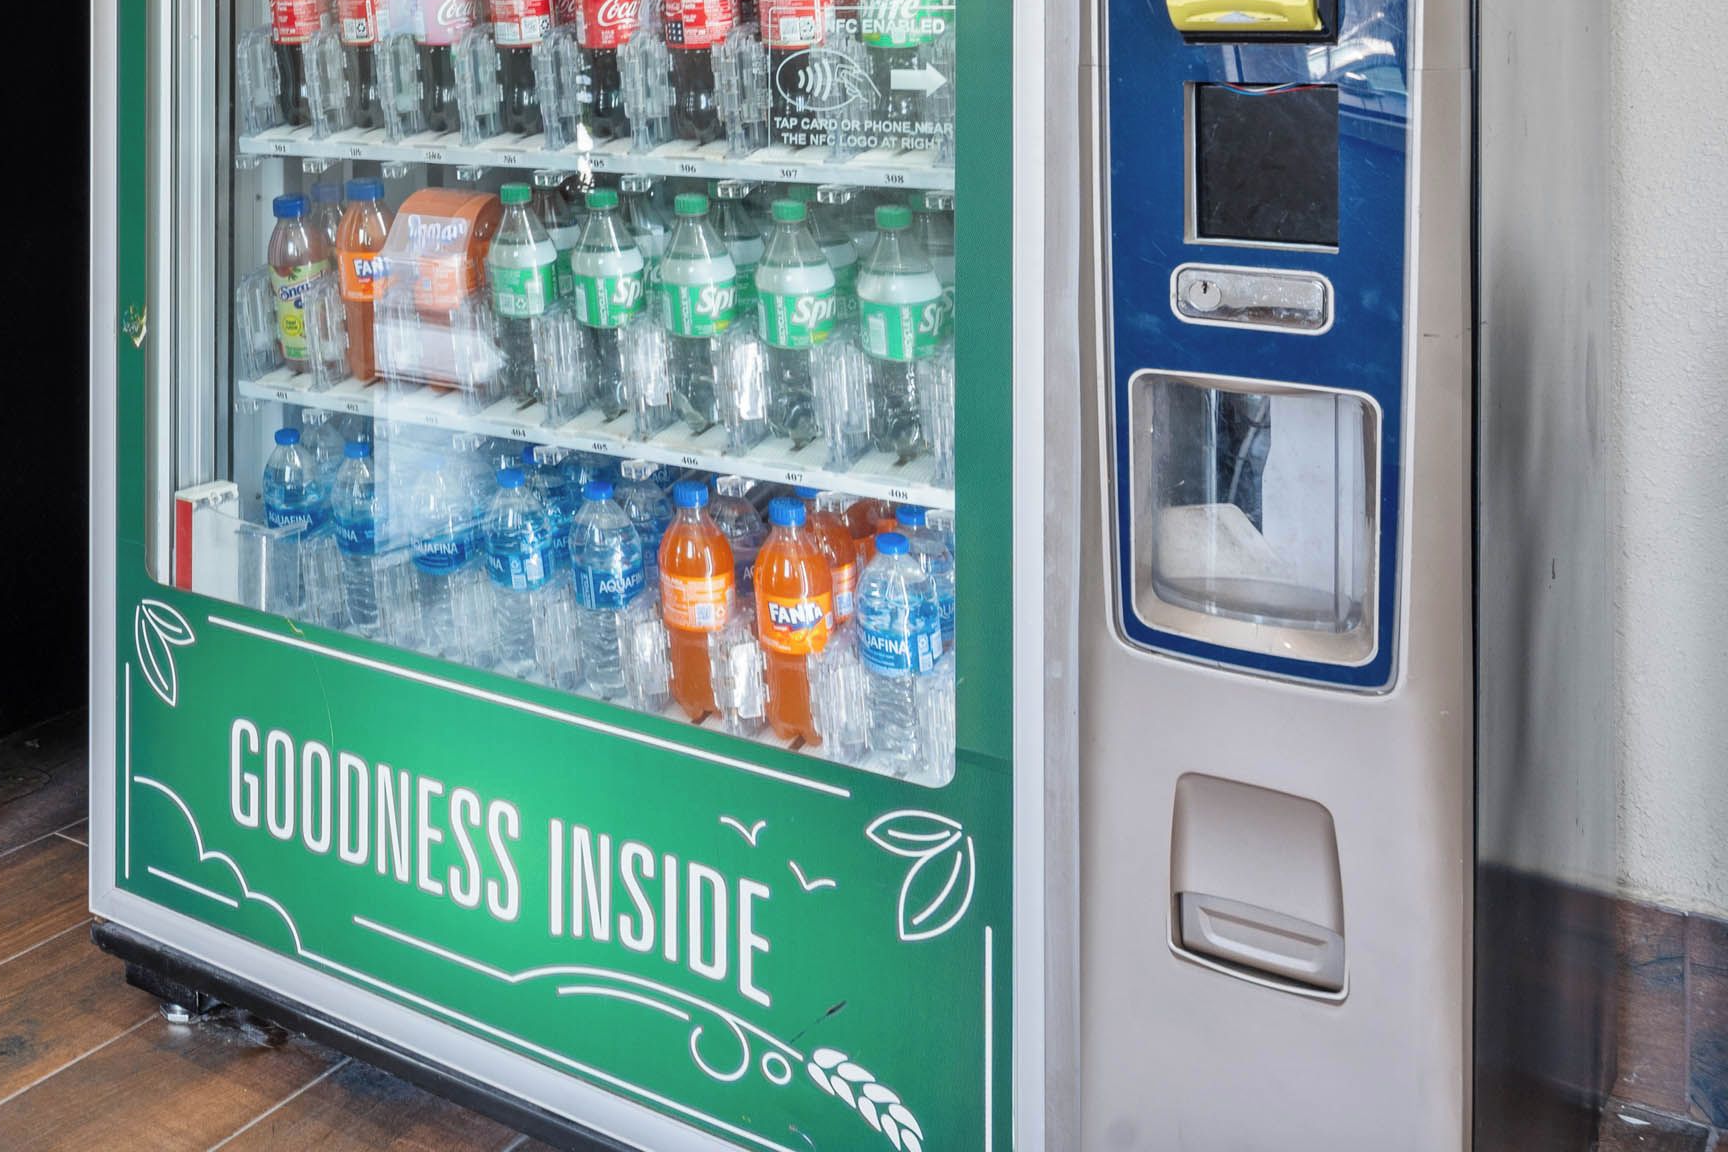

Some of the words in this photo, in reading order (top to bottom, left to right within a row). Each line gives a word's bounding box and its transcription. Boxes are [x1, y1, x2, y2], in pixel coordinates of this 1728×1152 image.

[826, 18, 858, 33] NFC
[862, 18, 946, 34] ENABLED
[774, 117, 798, 129] TAP
[801, 118, 838, 130] CARD
[841, 119, 861, 131] OR
[864, 120, 912, 133] PHONE
[914, 122, 954, 134] NEAR
[781, 132, 806, 145] THE
[810, 134, 836, 146] NFC
[839, 135, 878, 147] LOGO
[881, 137, 898, 148] AT
[901, 137, 944, 149] RIGHT
[679, 163, 696, 174] 306
[780, 168, 797, 179] 307
[884, 174, 904, 185] 308
[681, 455, 698, 466] 406
[785, 472, 803, 483] 407
[888, 488, 908, 500] 408
[769, 602, 823, 626] FANTA
[230, 718, 520, 922] GOODNESS
[549, 818, 771, 1007] INSIDE
